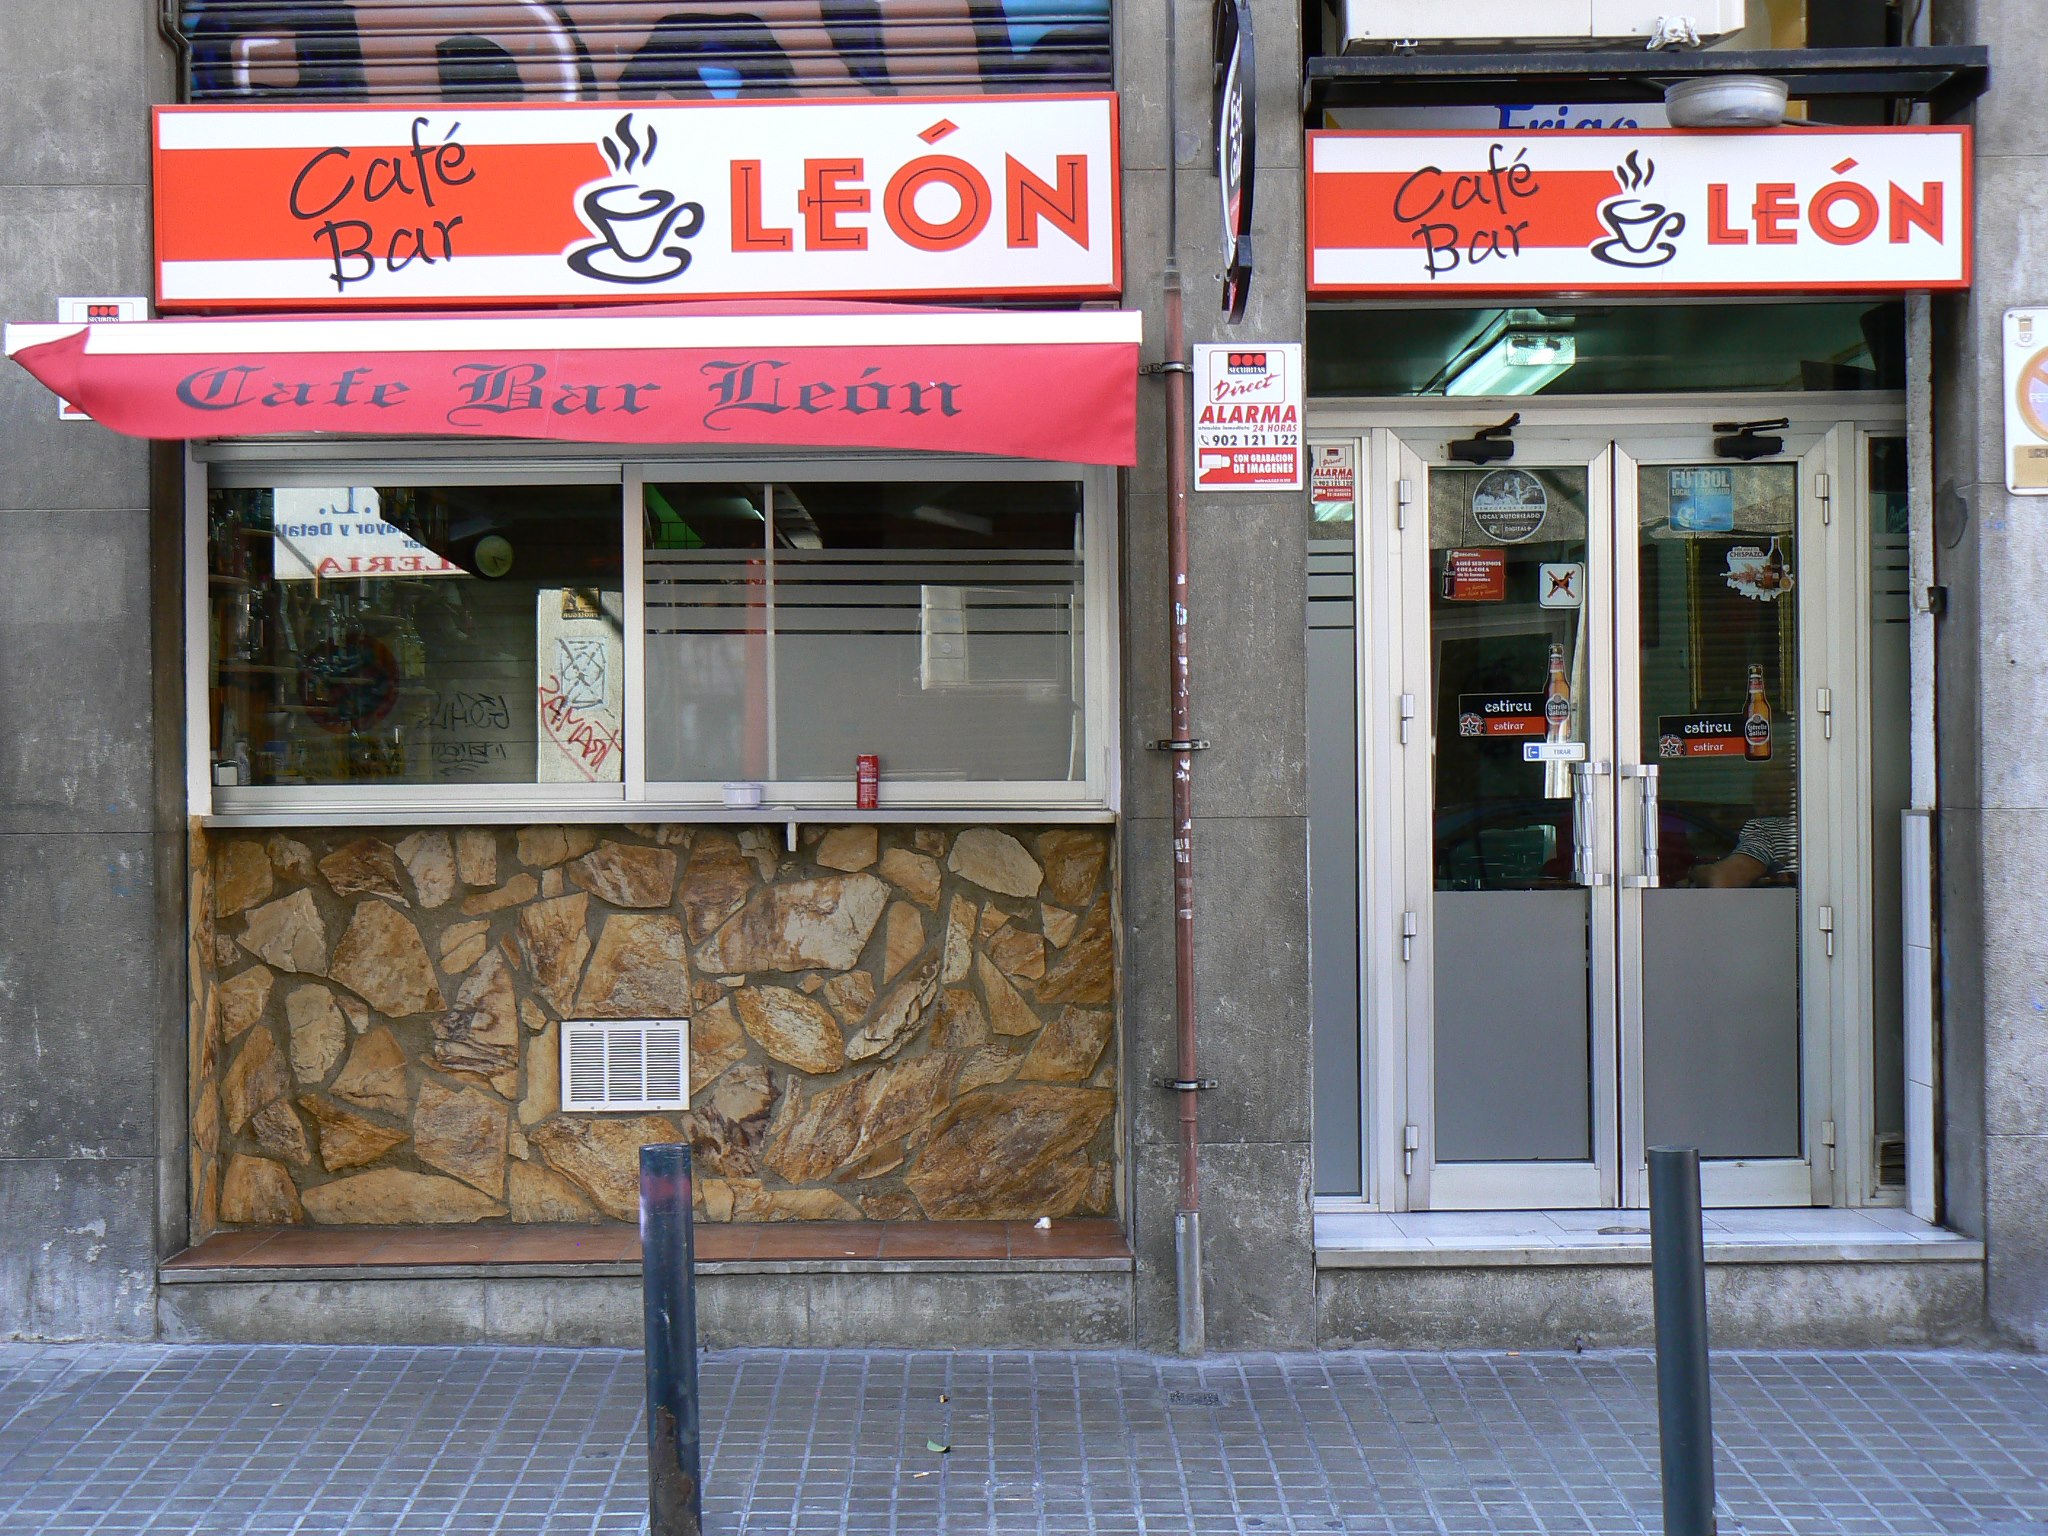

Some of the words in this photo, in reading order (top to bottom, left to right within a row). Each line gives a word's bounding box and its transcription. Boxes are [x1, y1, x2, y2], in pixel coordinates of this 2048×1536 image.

[290, 116, 475, 220] Café
[730, 118, 1088, 252] LEÓN
[1393, 144, 1540, 224] Café
[1707, 158, 1944, 245] LEÓN
[314, 215, 463, 291] Bar
[1413, 219, 1528, 280] Bar
[1229, 366, 1266, 374] SECURITAS
[1214, 373, 1280, 401] Direct
[176, 364, 411, 412] Cafe
[447, 363, 662, 427] Bar
[700, 360, 962, 431] León
[1199, 405, 1297, 424] ALARMA
[1252, 424, 1264, 433] 24
[1267, 424, 1297, 433] HORAS
[1212, 434, 1238, 446] 902
[1243, 434, 1266, 446] 121
[1274, 434, 1298, 446] 122
[1233, 453, 1249, 463] CON
[1250, 453, 1294, 463] GRABACION
[1233, 463, 1246, 474] DE
[1247, 463, 1294, 474] IMAGENES
[1313, 468, 1353, 477] ALARMA
[1499, 512, 1541, 520] AUTORIZADO
[1484, 700, 1532, 713] estireu
[1493, 721, 1525, 731] estirar
[1684, 720, 1732, 734] estireu
[1693, 742, 1724, 751] estirar
